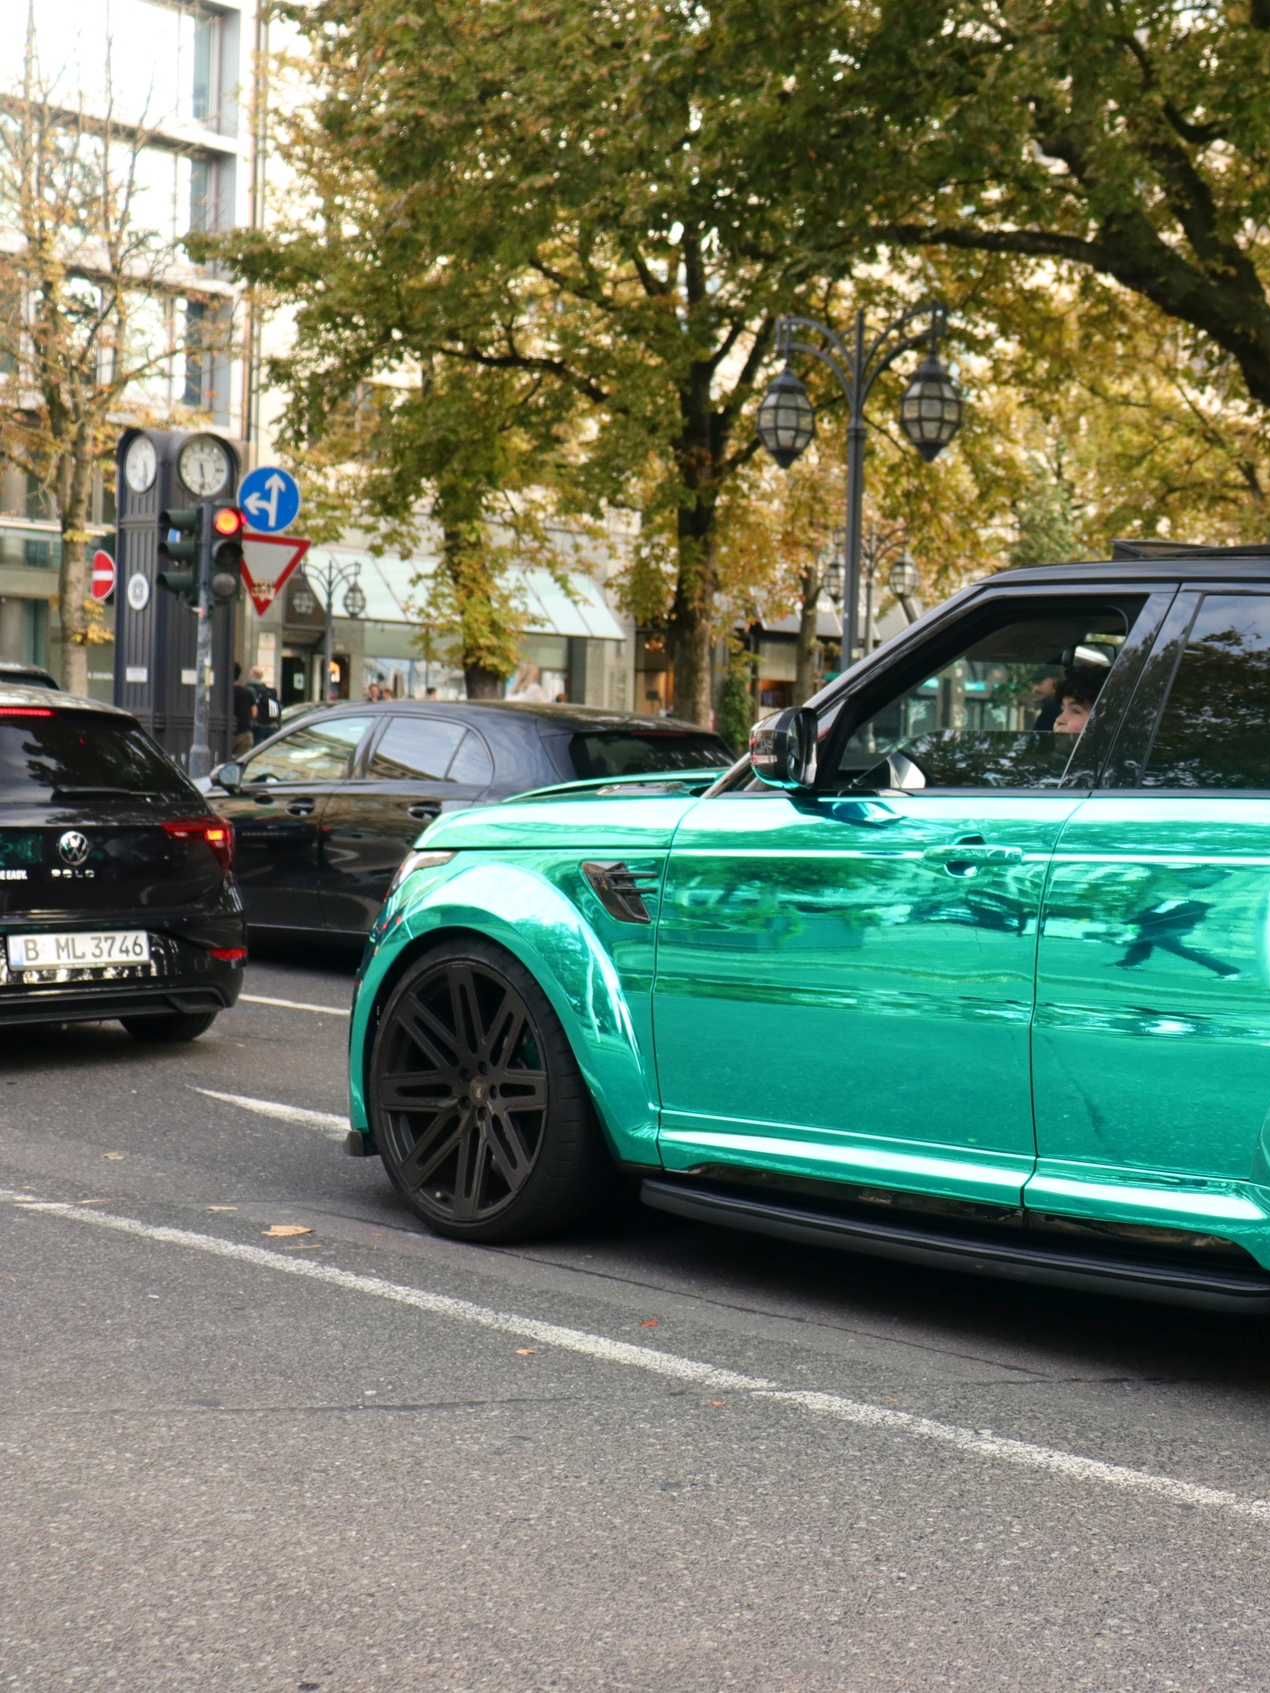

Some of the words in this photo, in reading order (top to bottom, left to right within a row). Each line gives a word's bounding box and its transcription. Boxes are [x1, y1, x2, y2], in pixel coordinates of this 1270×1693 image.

[23, 938, 40, 962] B
[55, 937, 86, 961] ML
[90, 935, 144, 959] 3746
